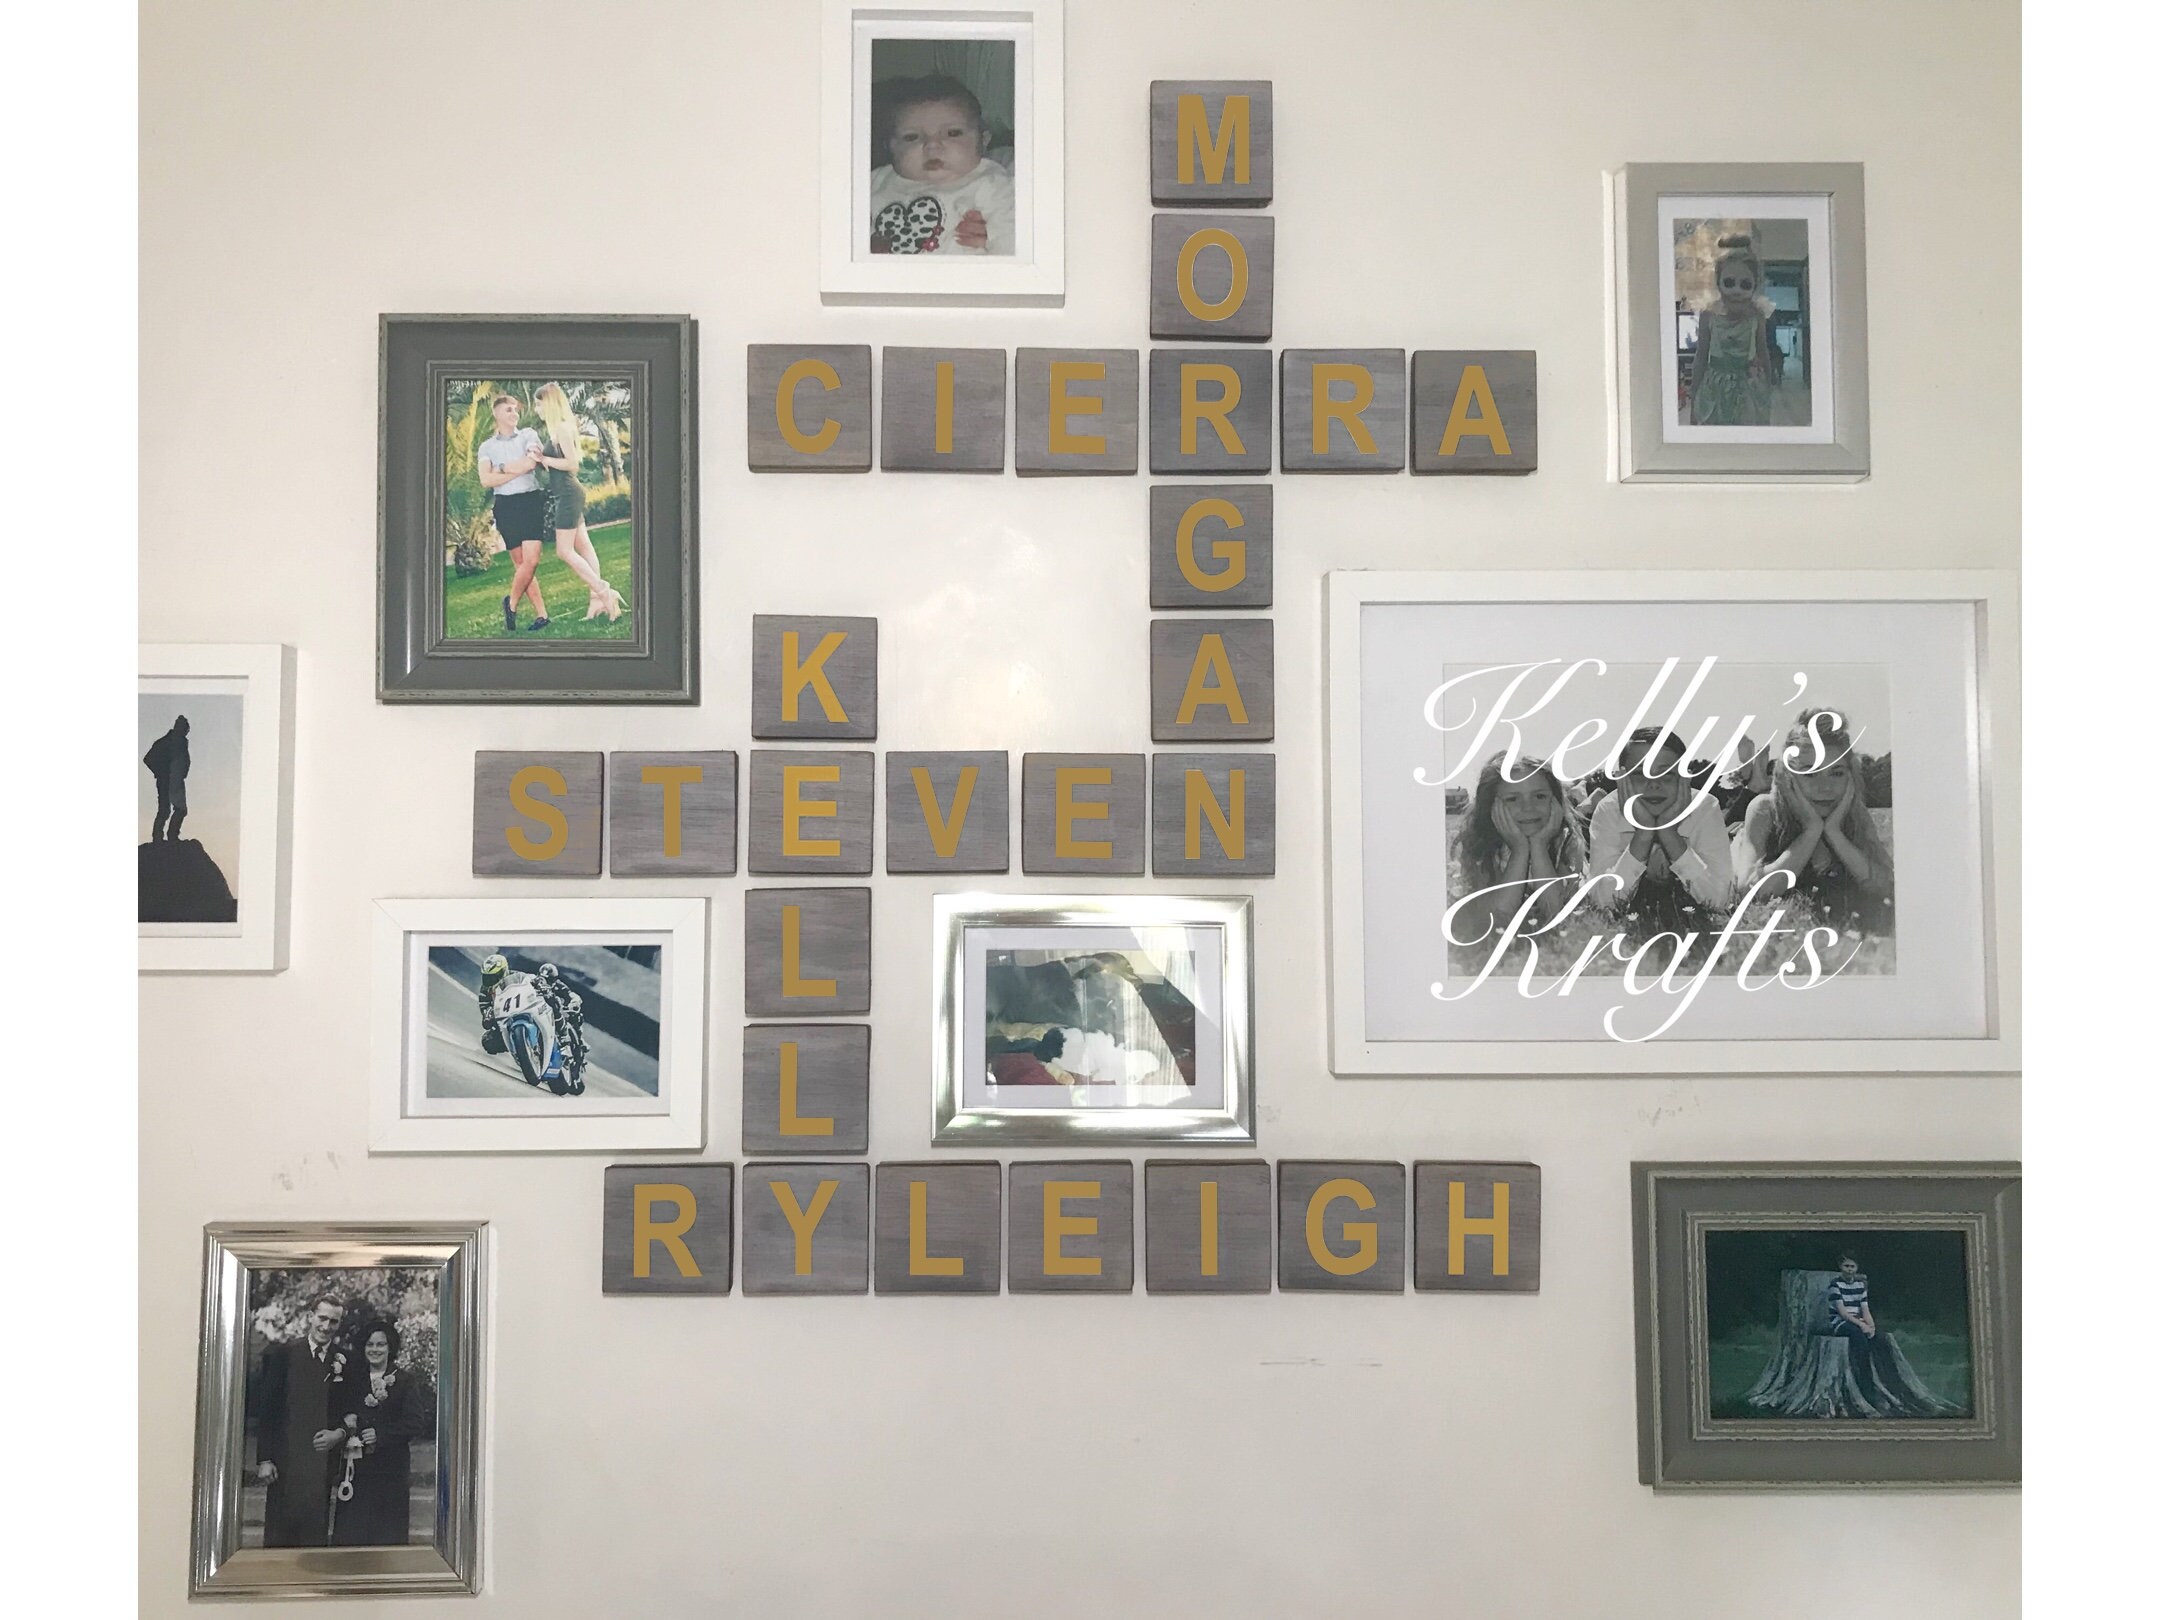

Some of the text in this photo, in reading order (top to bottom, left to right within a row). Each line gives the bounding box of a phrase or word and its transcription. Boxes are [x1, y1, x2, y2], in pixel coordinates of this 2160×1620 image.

[777, 361, 1511, 454] CIERRA
[1178, 95, 1248, 859] MORGAN
[507, 766, 1244, 859] STEVEN
[770, 632, 847, 1274] KELLY
[504, 993, 521, 1012] 41
[635, 1180, 1509, 1276] RYLEIGH
